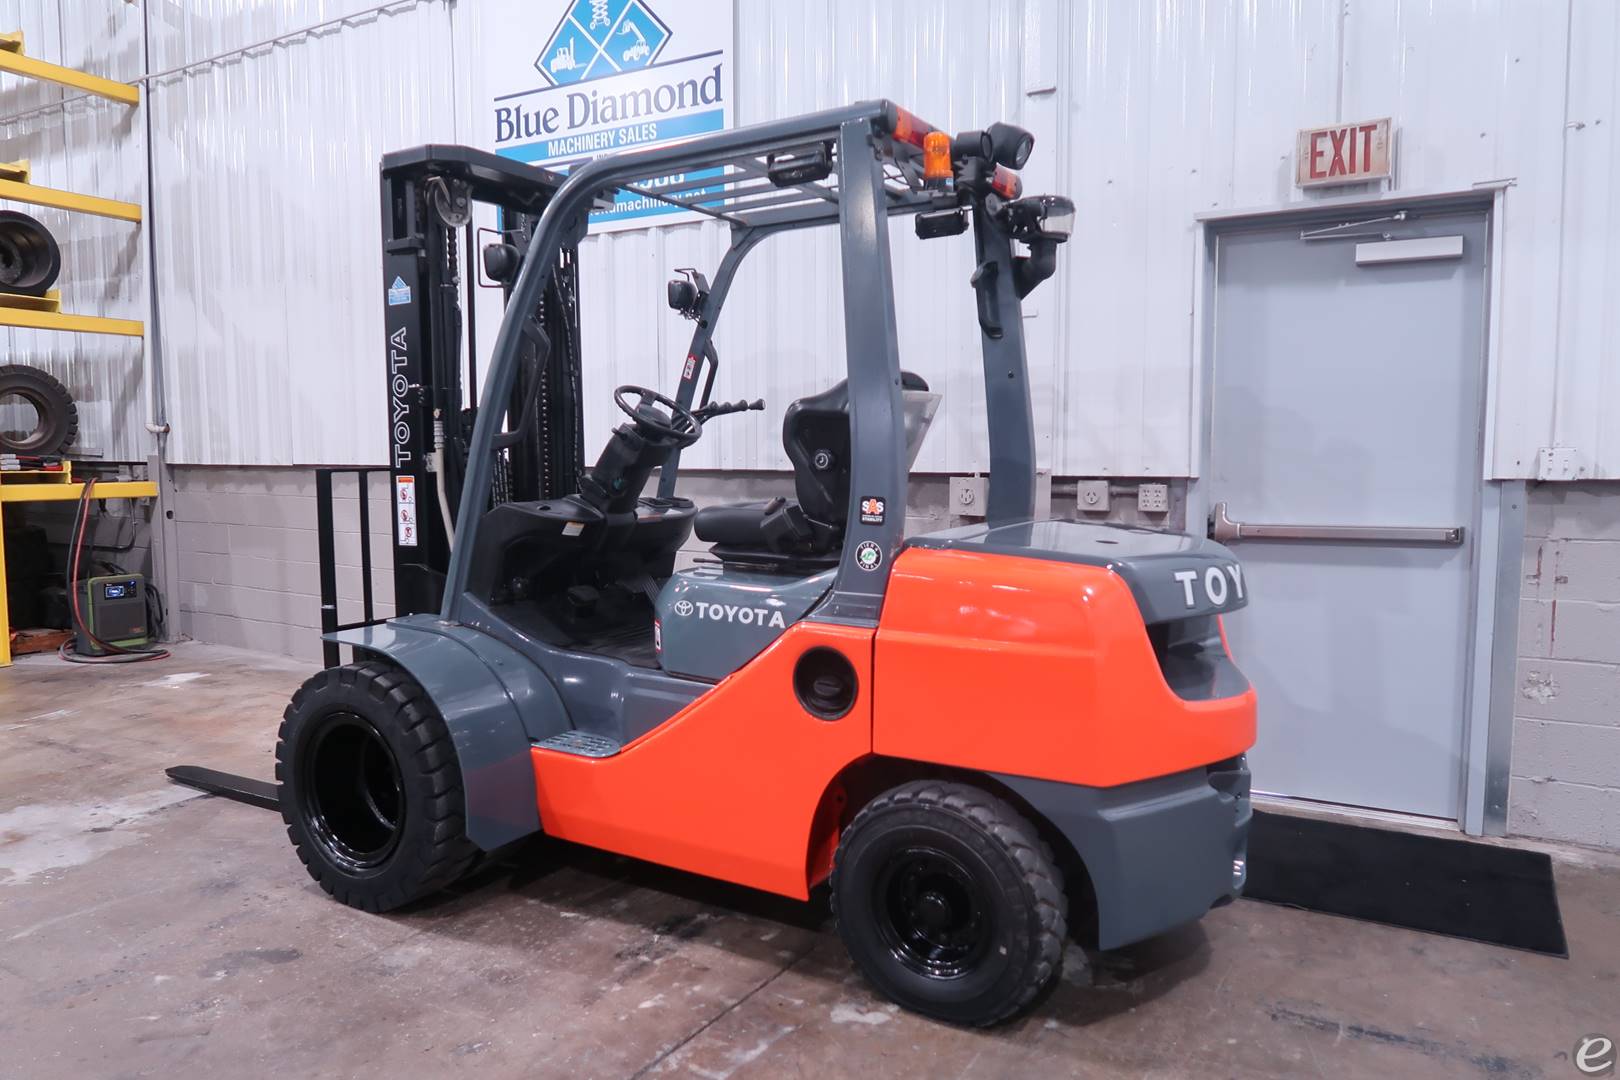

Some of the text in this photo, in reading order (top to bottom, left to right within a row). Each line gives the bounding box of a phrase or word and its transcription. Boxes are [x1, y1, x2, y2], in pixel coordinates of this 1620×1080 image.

[494, 63, 723, 143] Blue Diamond
[548, 123, 657, 157] MACHINERY SALES
[1310, 124, 1377, 179] EXIT
[391, 327, 411, 468] TOYOTA
[862, 499, 884, 514] SAS
[696, 602, 786, 629] TOYOTA
